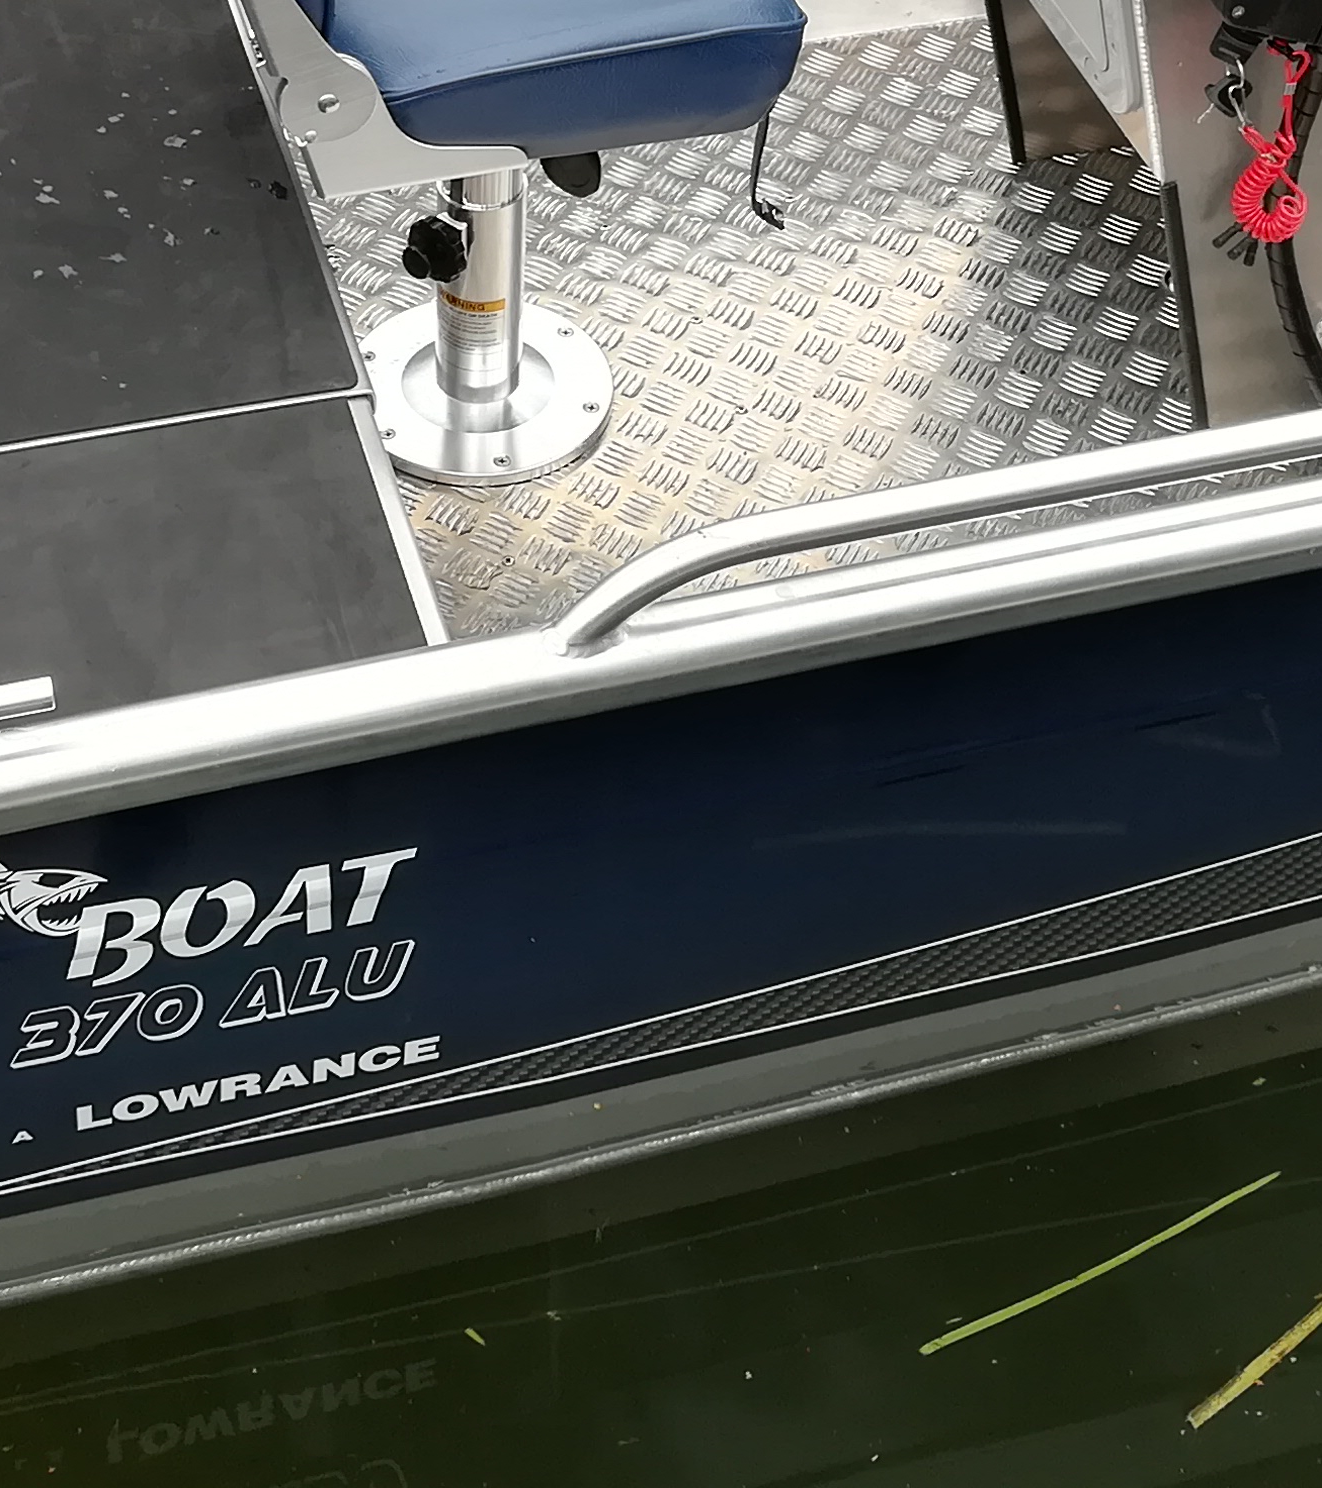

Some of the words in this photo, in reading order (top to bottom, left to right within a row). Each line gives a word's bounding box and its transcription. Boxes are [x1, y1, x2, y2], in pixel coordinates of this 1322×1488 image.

[67, 848, 417, 987] BOAT
[10, 984, 204, 1069] 370
[219, 940, 416, 1028] ALU
[76, 1036, 441, 1131] LOWRANCE
